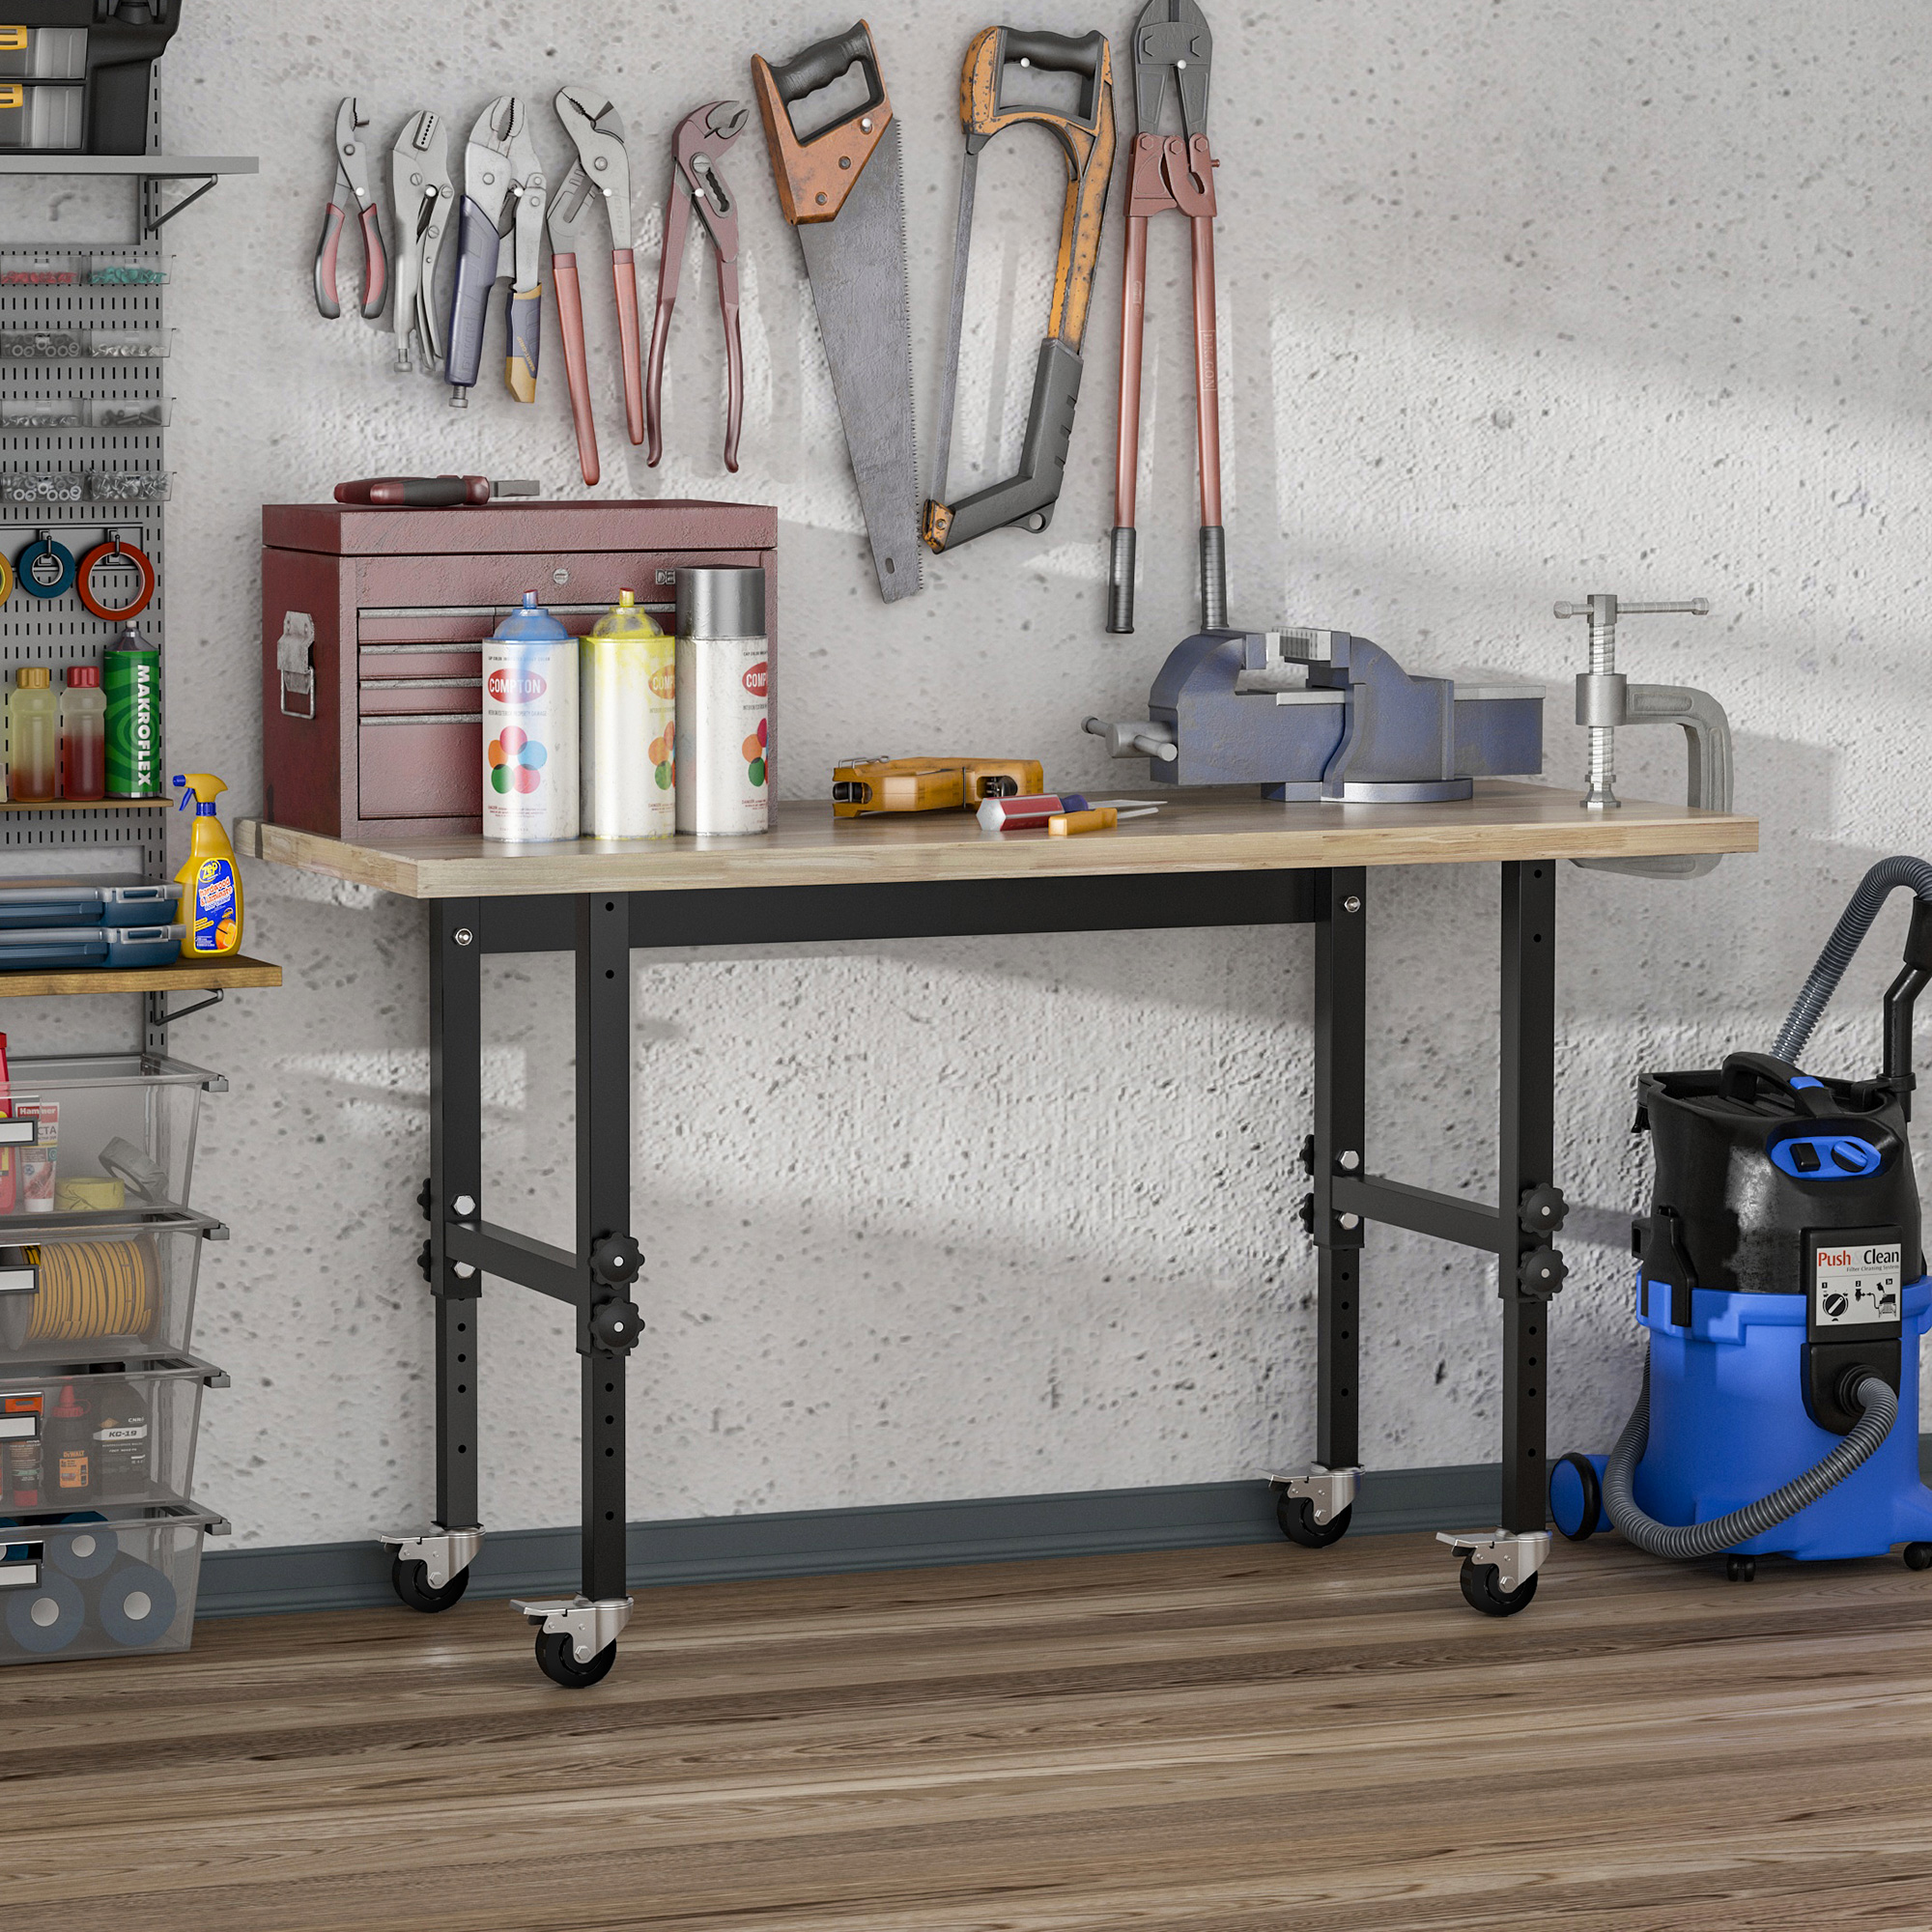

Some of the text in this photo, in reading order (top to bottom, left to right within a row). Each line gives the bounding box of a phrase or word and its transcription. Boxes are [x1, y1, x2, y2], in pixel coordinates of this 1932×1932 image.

[489, 678, 541, 694] COMPTON
[652, 675, 673, 691] COMP
[746, 672, 767, 688] COMP
[137, 664, 152, 786] MAKROFLEX
[1818, 1249, 1851, 1266] Push
[1863, 1248, 1899, 1264] Clean
